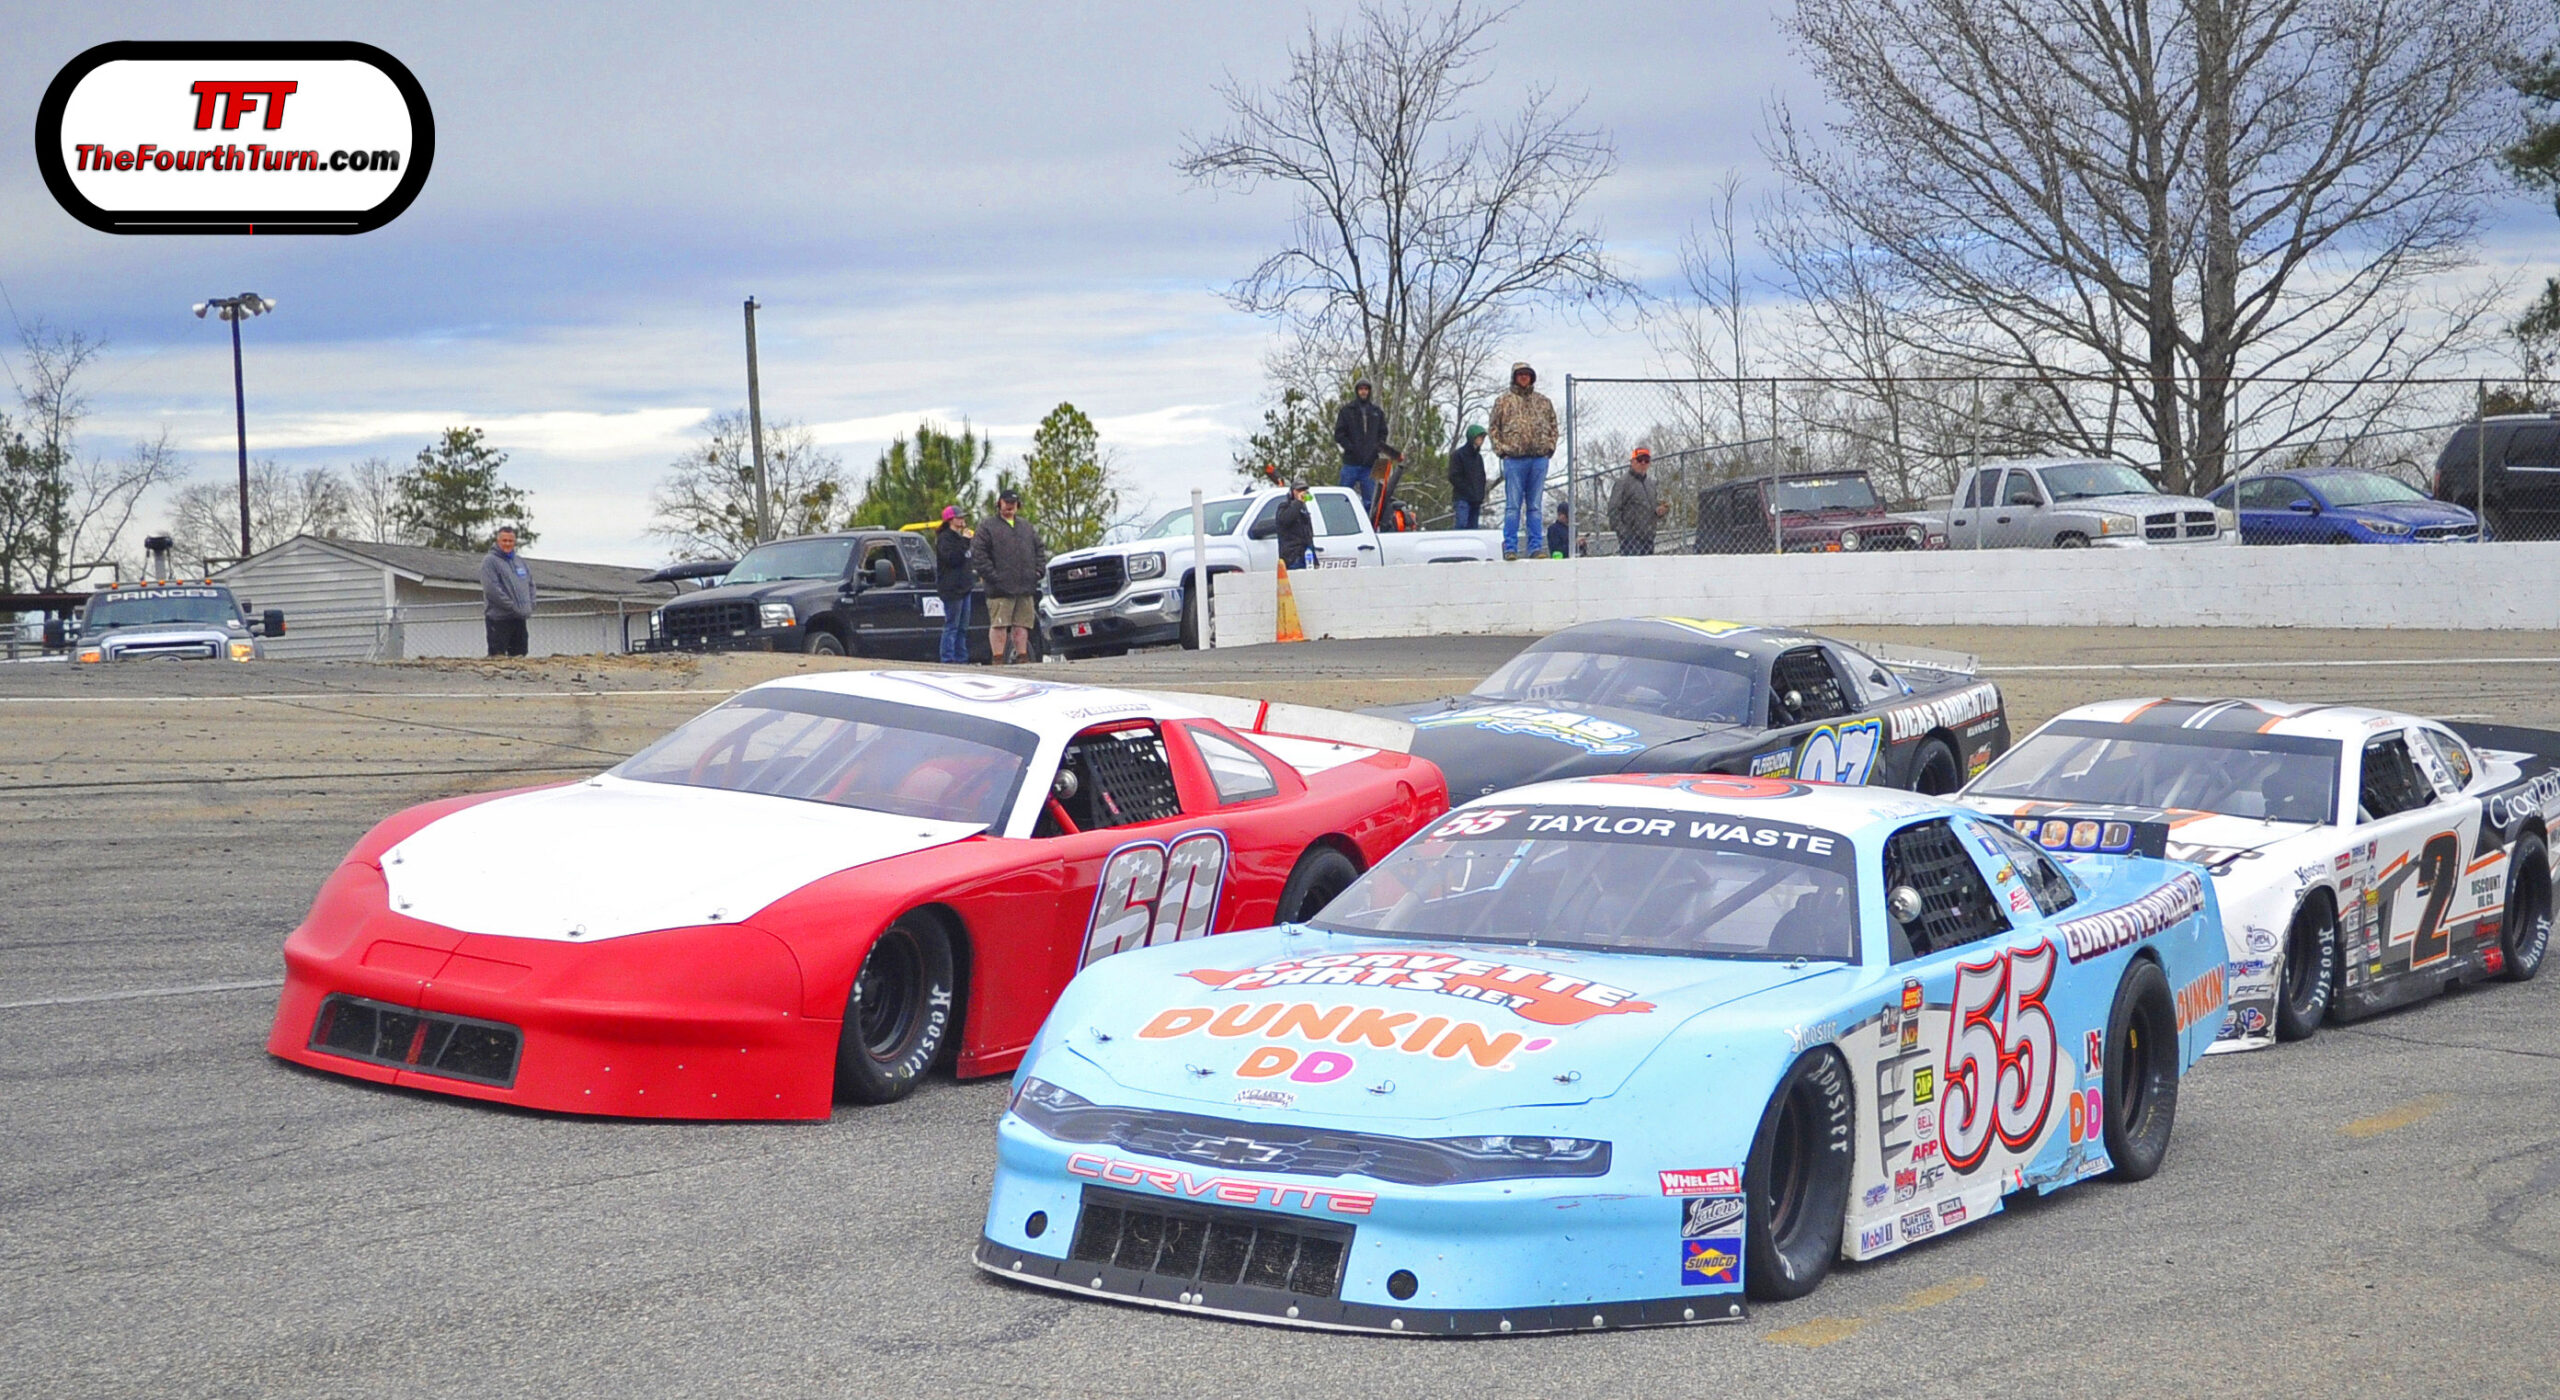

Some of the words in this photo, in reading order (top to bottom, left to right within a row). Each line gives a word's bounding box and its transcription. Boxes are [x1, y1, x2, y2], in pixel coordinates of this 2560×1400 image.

[1888, 703, 1938, 741] LUCAS
[1795, 717, 1883, 786] 07
[1430, 807, 1526, 840] 55
[1526, 814, 1675, 837] TAYLOR
[1687, 821, 1836, 857] WASTE
[1078, 828, 1230, 975] 60
[2410, 828, 2462, 972] 2
[2471, 874, 2501, 896] DISCOUNT
[1253, 952, 1638, 1008] CORVETTE
[2235, 984, 2274, 996] PFC
[904, 983, 951, 1079] Hoosier
[1783, 1020, 1838, 1053] Hoosier
[1939, 936, 2058, 1175] 55
[1917, 1114, 1934, 1131] BELL
[1911, 1139, 1938, 1163] ARP
[1066, 1151, 1378, 1215] CORVETTE
[1660, 1168, 1736, 1188] WHELEN
[1861, 1226, 1884, 1251] Mobil
[1885, 1223, 1893, 1242] 1
[1905, 1221, 1935, 1239] MASTER
[1686, 1255, 1737, 1270] SUNOCO
